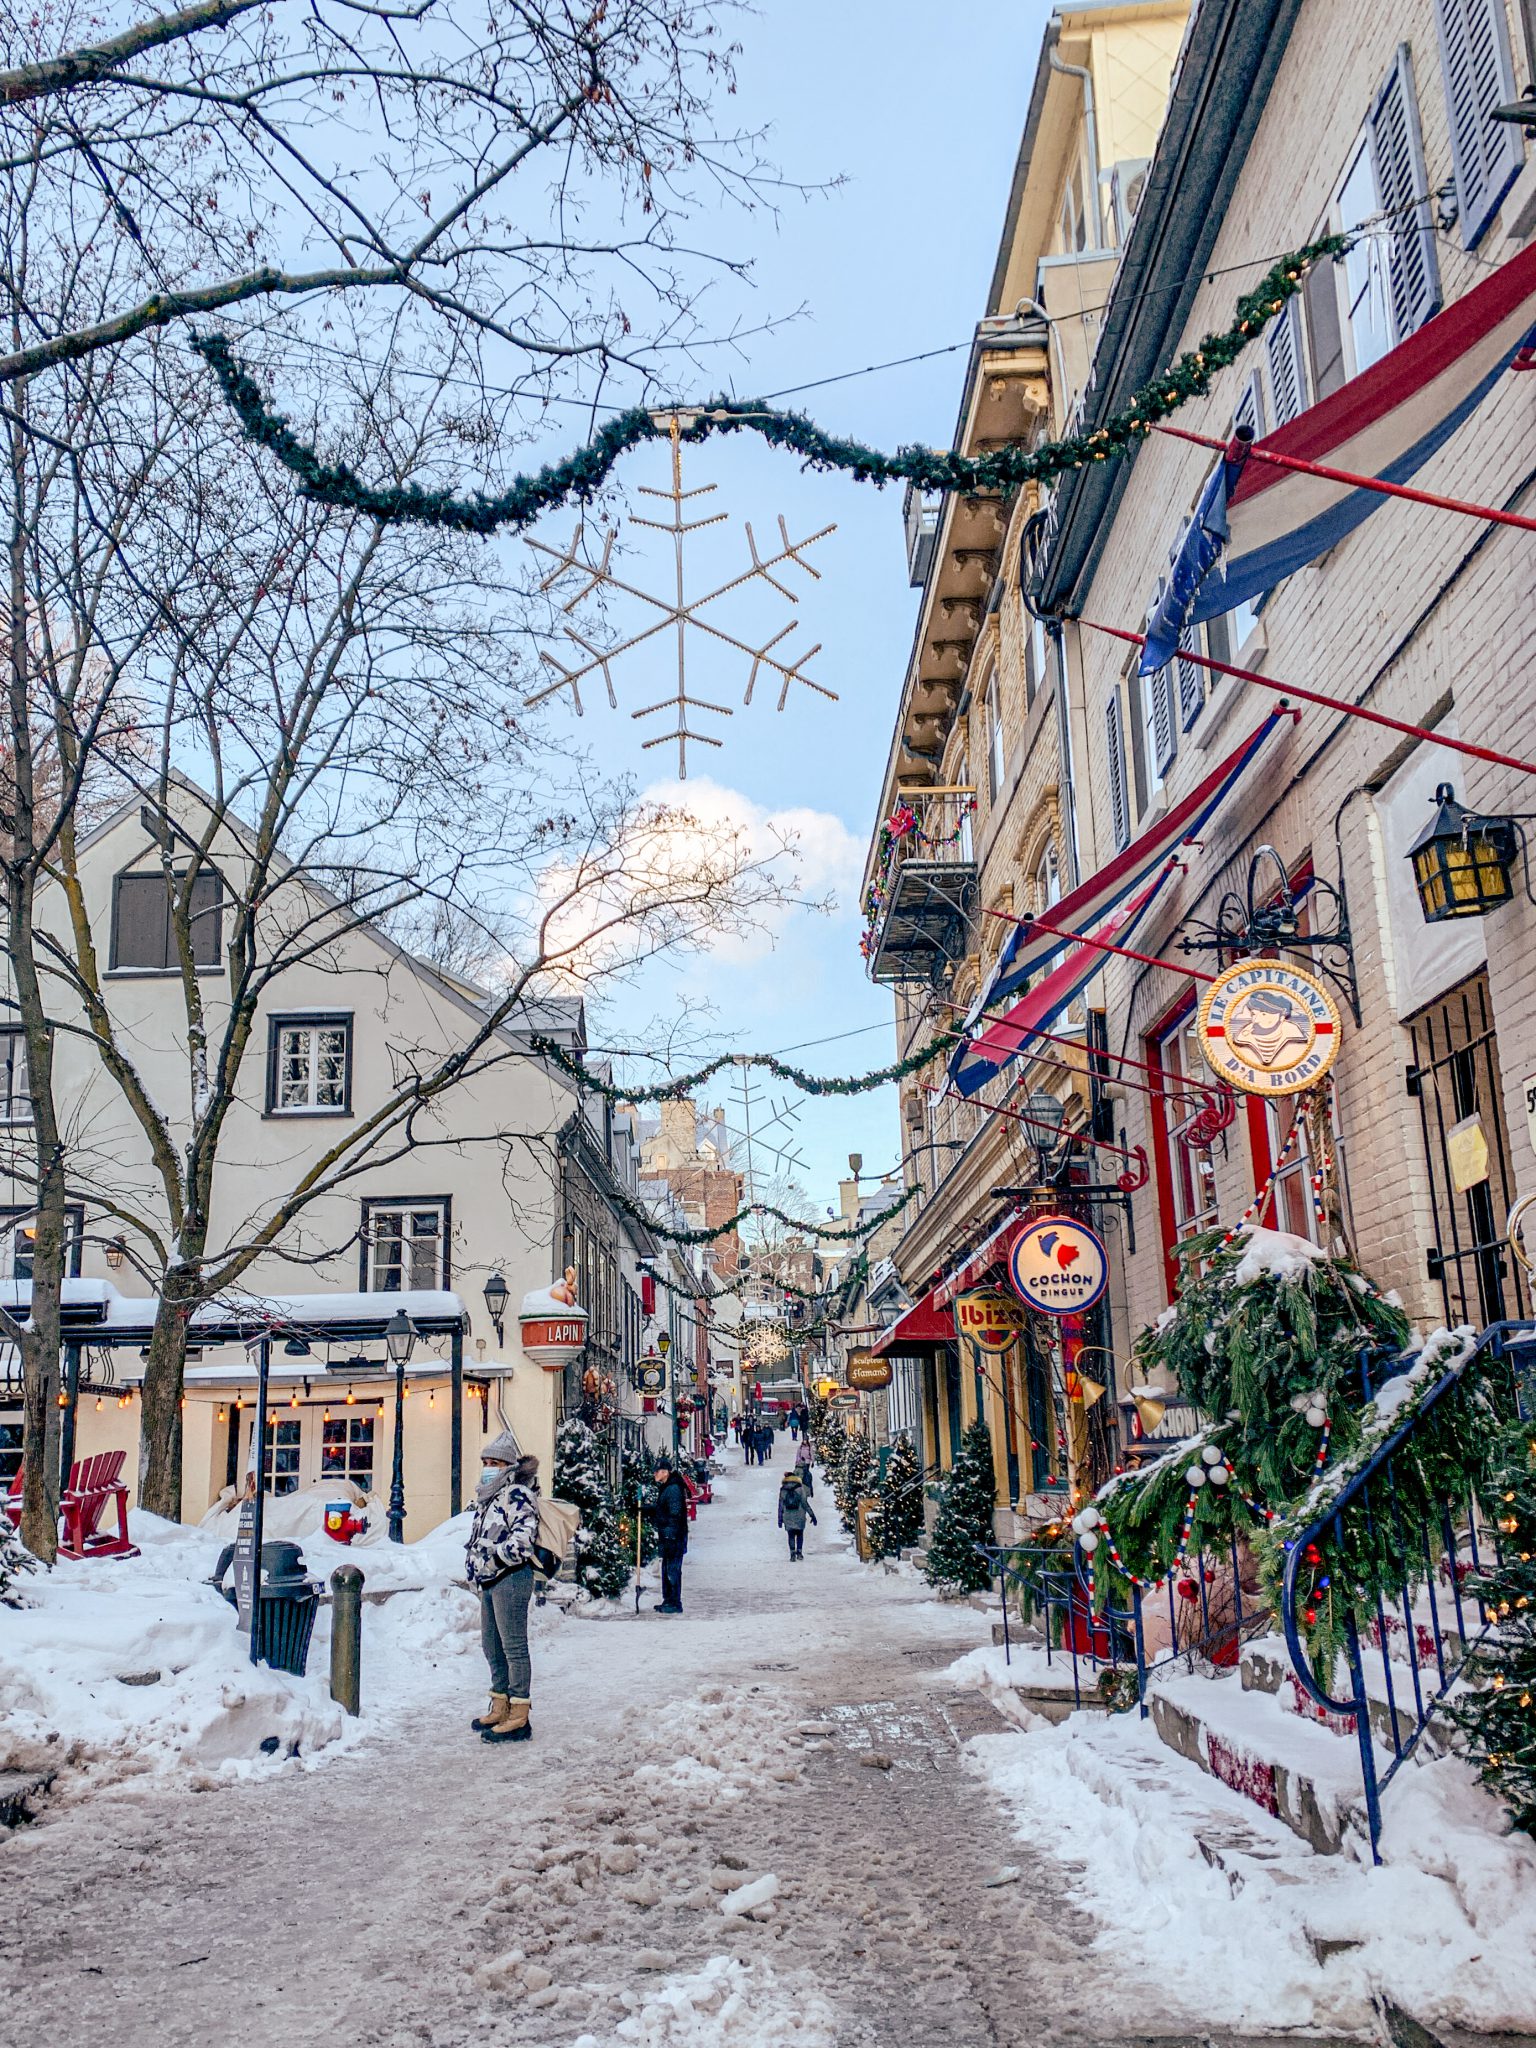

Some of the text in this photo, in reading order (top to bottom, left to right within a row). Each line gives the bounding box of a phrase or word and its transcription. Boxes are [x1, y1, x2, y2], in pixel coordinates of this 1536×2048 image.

[1210, 969, 1327, 1021] LE CAPITAINE
[1224, 1054, 1322, 1087] D'A BORD
[1527, 1087, 1536, 1113] 5
[1029, 1273, 1093, 1287] COCHON
[1041, 1288, 1084, 1297] DINGUE
[961, 1303, 1022, 1325] Ibiza
[548, 1324, 578, 1342] LAPIN
